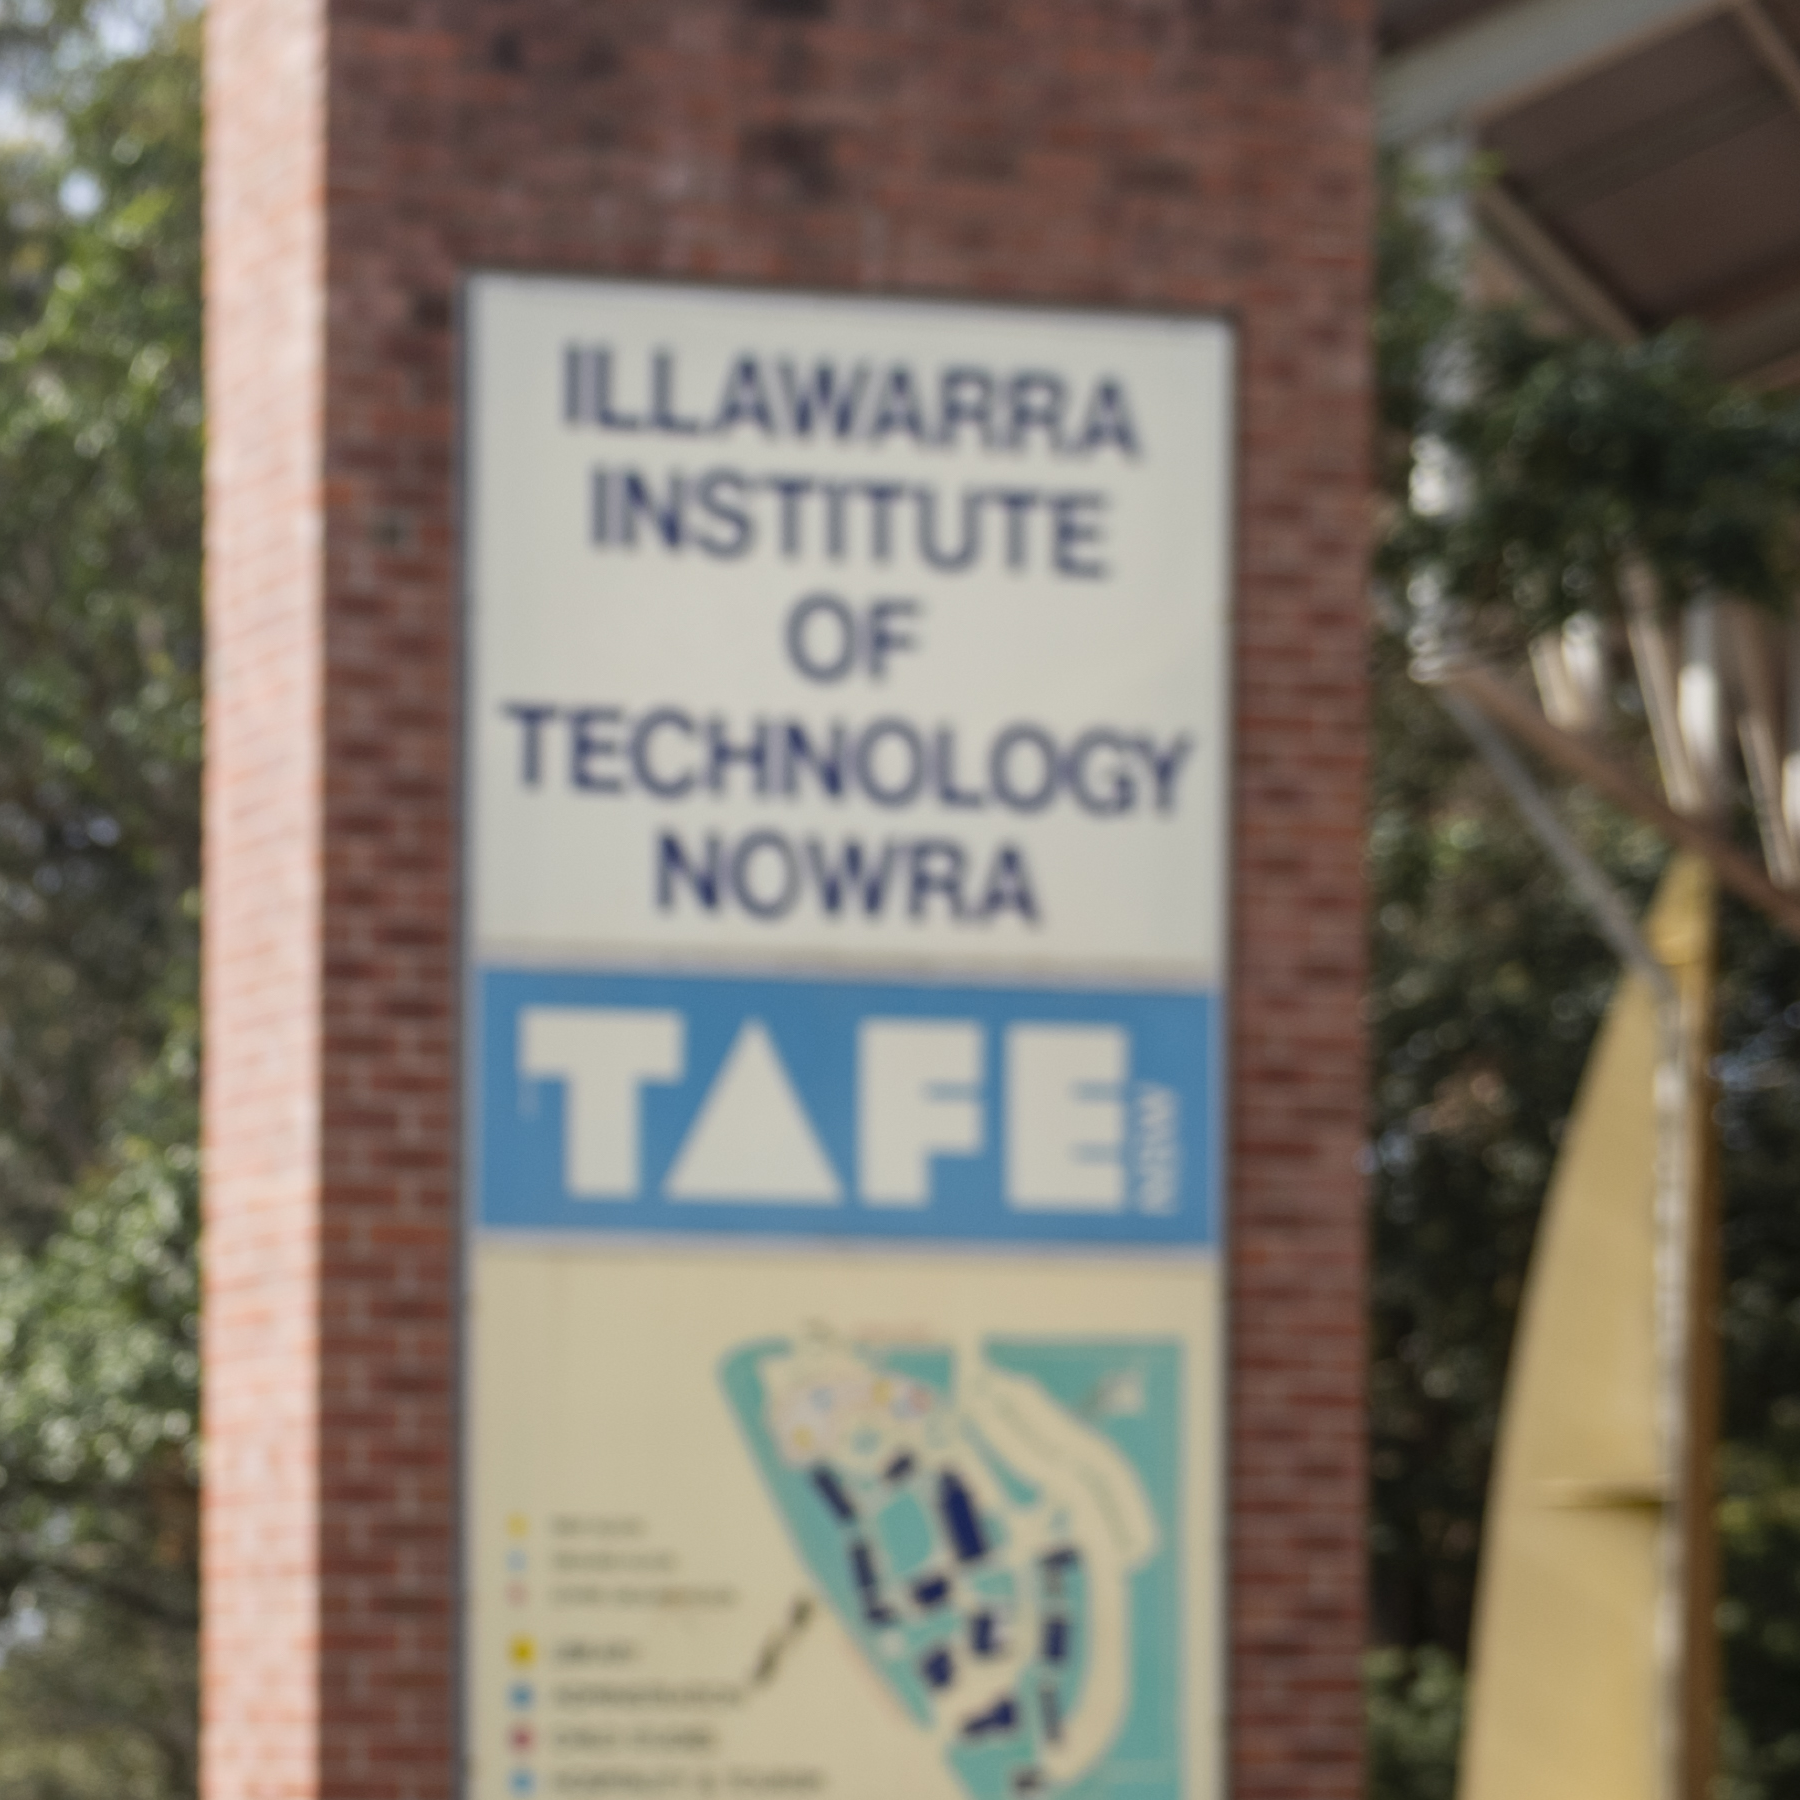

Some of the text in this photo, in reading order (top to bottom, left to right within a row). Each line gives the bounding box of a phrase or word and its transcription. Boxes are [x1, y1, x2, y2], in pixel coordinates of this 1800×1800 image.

[562, 343, 1140, 456] ILLAWARRA
[591, 468, 1103, 578] INSTITUTE
[787, 595, 915, 683] OF
[504, 702, 1192, 816] TECHNOLOGY
[656, 830, 1040, 922] NOWRA
[518, 1006, 1130, 1212] TAFE
